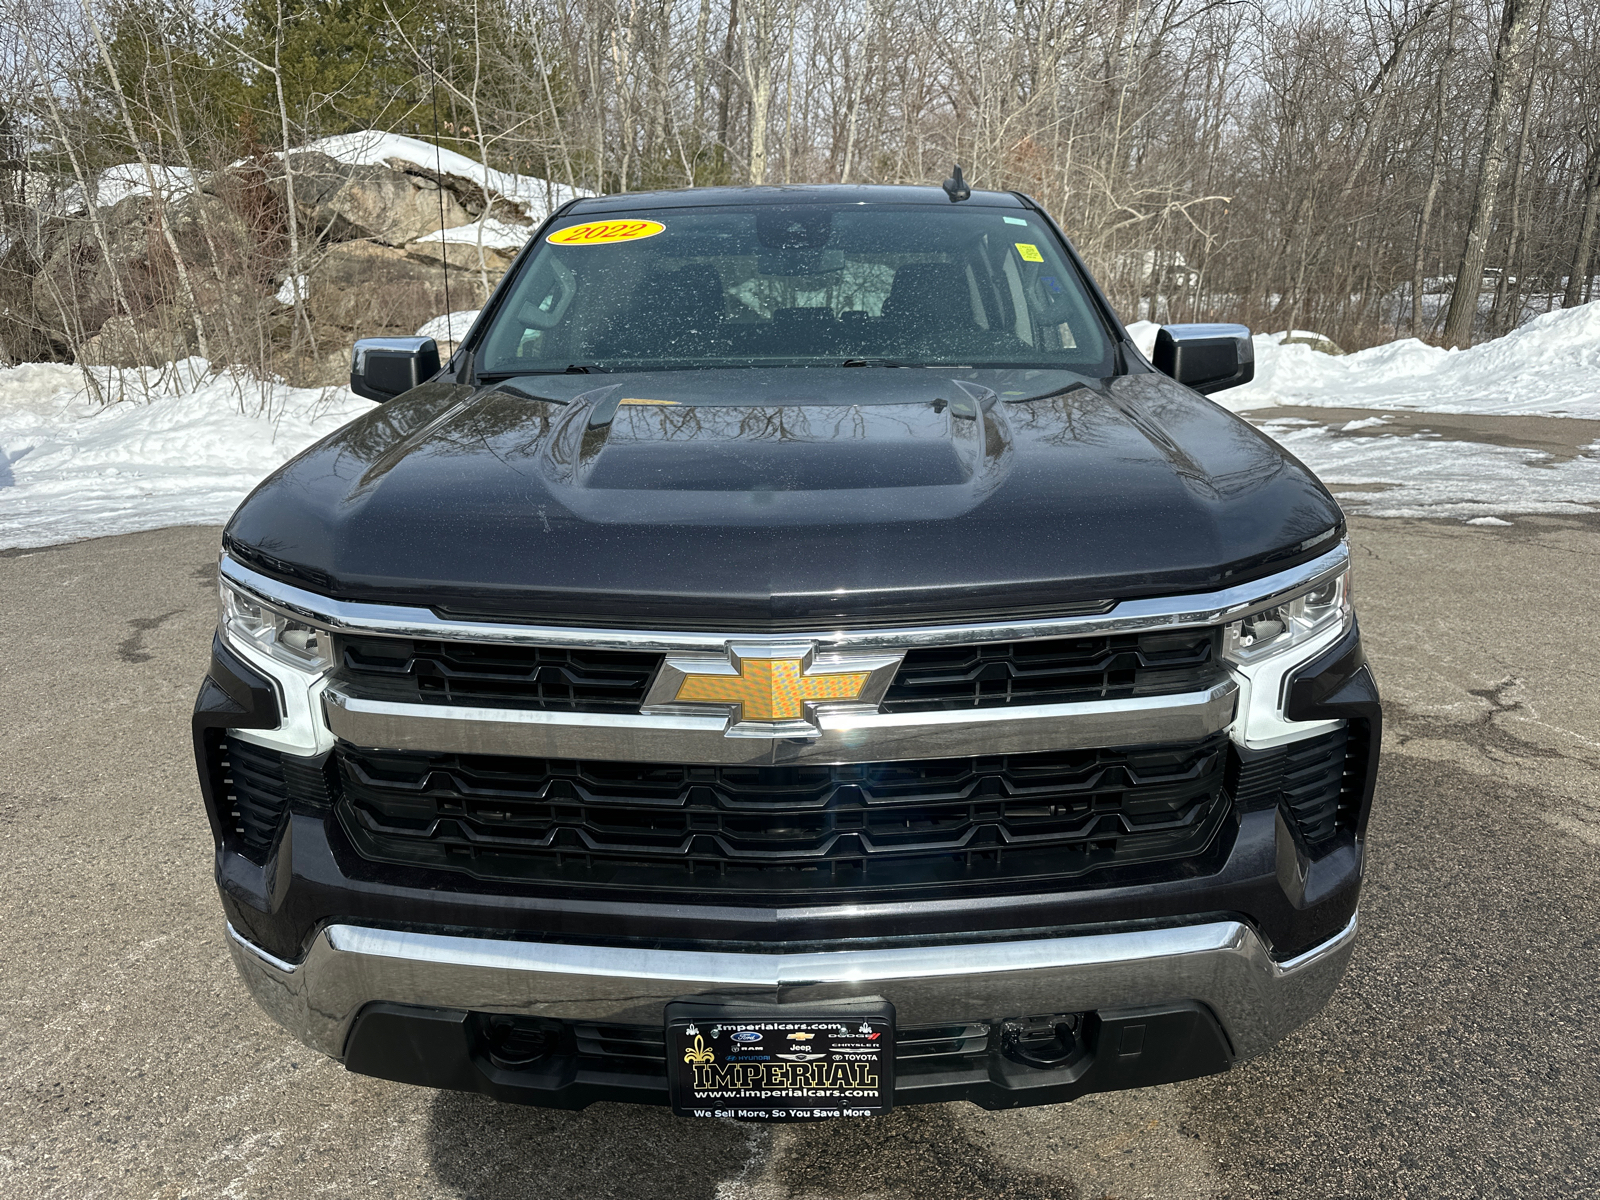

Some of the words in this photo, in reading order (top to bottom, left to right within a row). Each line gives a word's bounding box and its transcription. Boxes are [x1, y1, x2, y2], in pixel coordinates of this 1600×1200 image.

[562, 223, 648, 242] 2022
[716, 1022, 841, 1032] Imperialcars.com
[790, 1044, 812, 1052] Jeep
[693, 1062, 879, 1090] IMPERIAL
[694, 1088, 879, 1099] www.imperialcars.com
[694, 1110, 712, 1118] We
[715, 1109, 735, 1118] Sell
[738, 1109, 769, 1119] More,
[772, 1109, 786, 1118] So
[789, 1109, 811, 1118] You
[813, 1109, 840, 1118] Save
[843, 1108, 871, 1117] More
